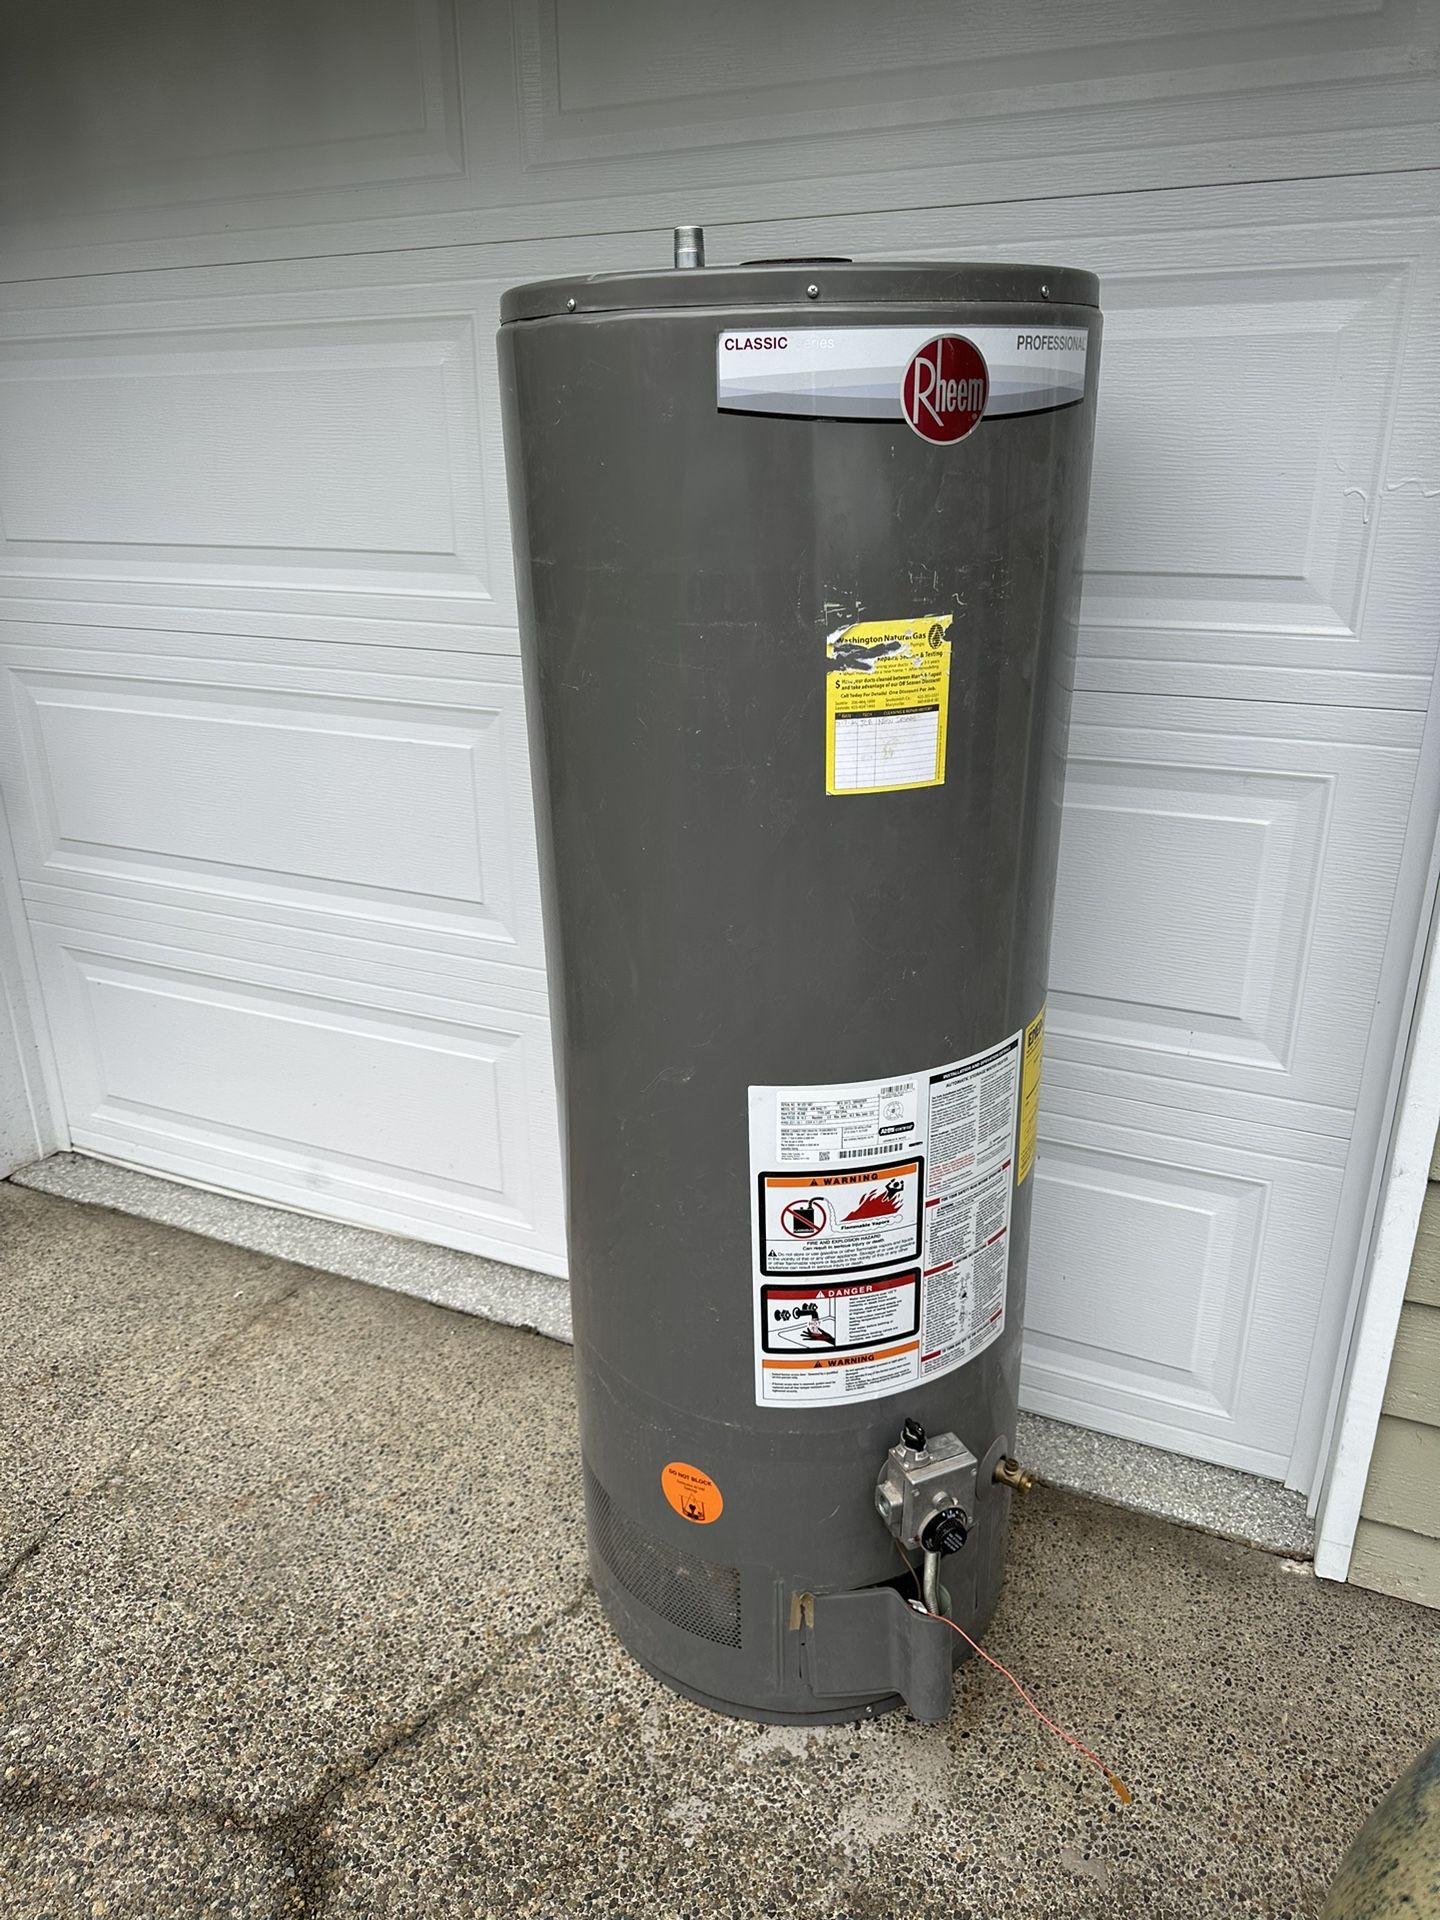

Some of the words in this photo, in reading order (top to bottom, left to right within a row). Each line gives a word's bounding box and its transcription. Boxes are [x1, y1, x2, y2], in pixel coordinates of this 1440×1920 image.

[724, 336, 788, 351] CLASSIC
[796, 337, 835, 350] eries
[1017, 335, 1086, 351] PROFESSIONAL
[913, 339, 984, 427] Rheem
[912, 632, 927, 640] Gas
[835, 680, 841, 689] $
[824, 1173, 878, 1186] WARNING
[828, 1286, 873, 1297] DANGER
[828, 1355, 874, 1367] WARNING
[668, 1468, 677, 1476] DO
[678, 1472, 690, 1480] NOT
[691, 1477, 713, 1487] BLOCK
